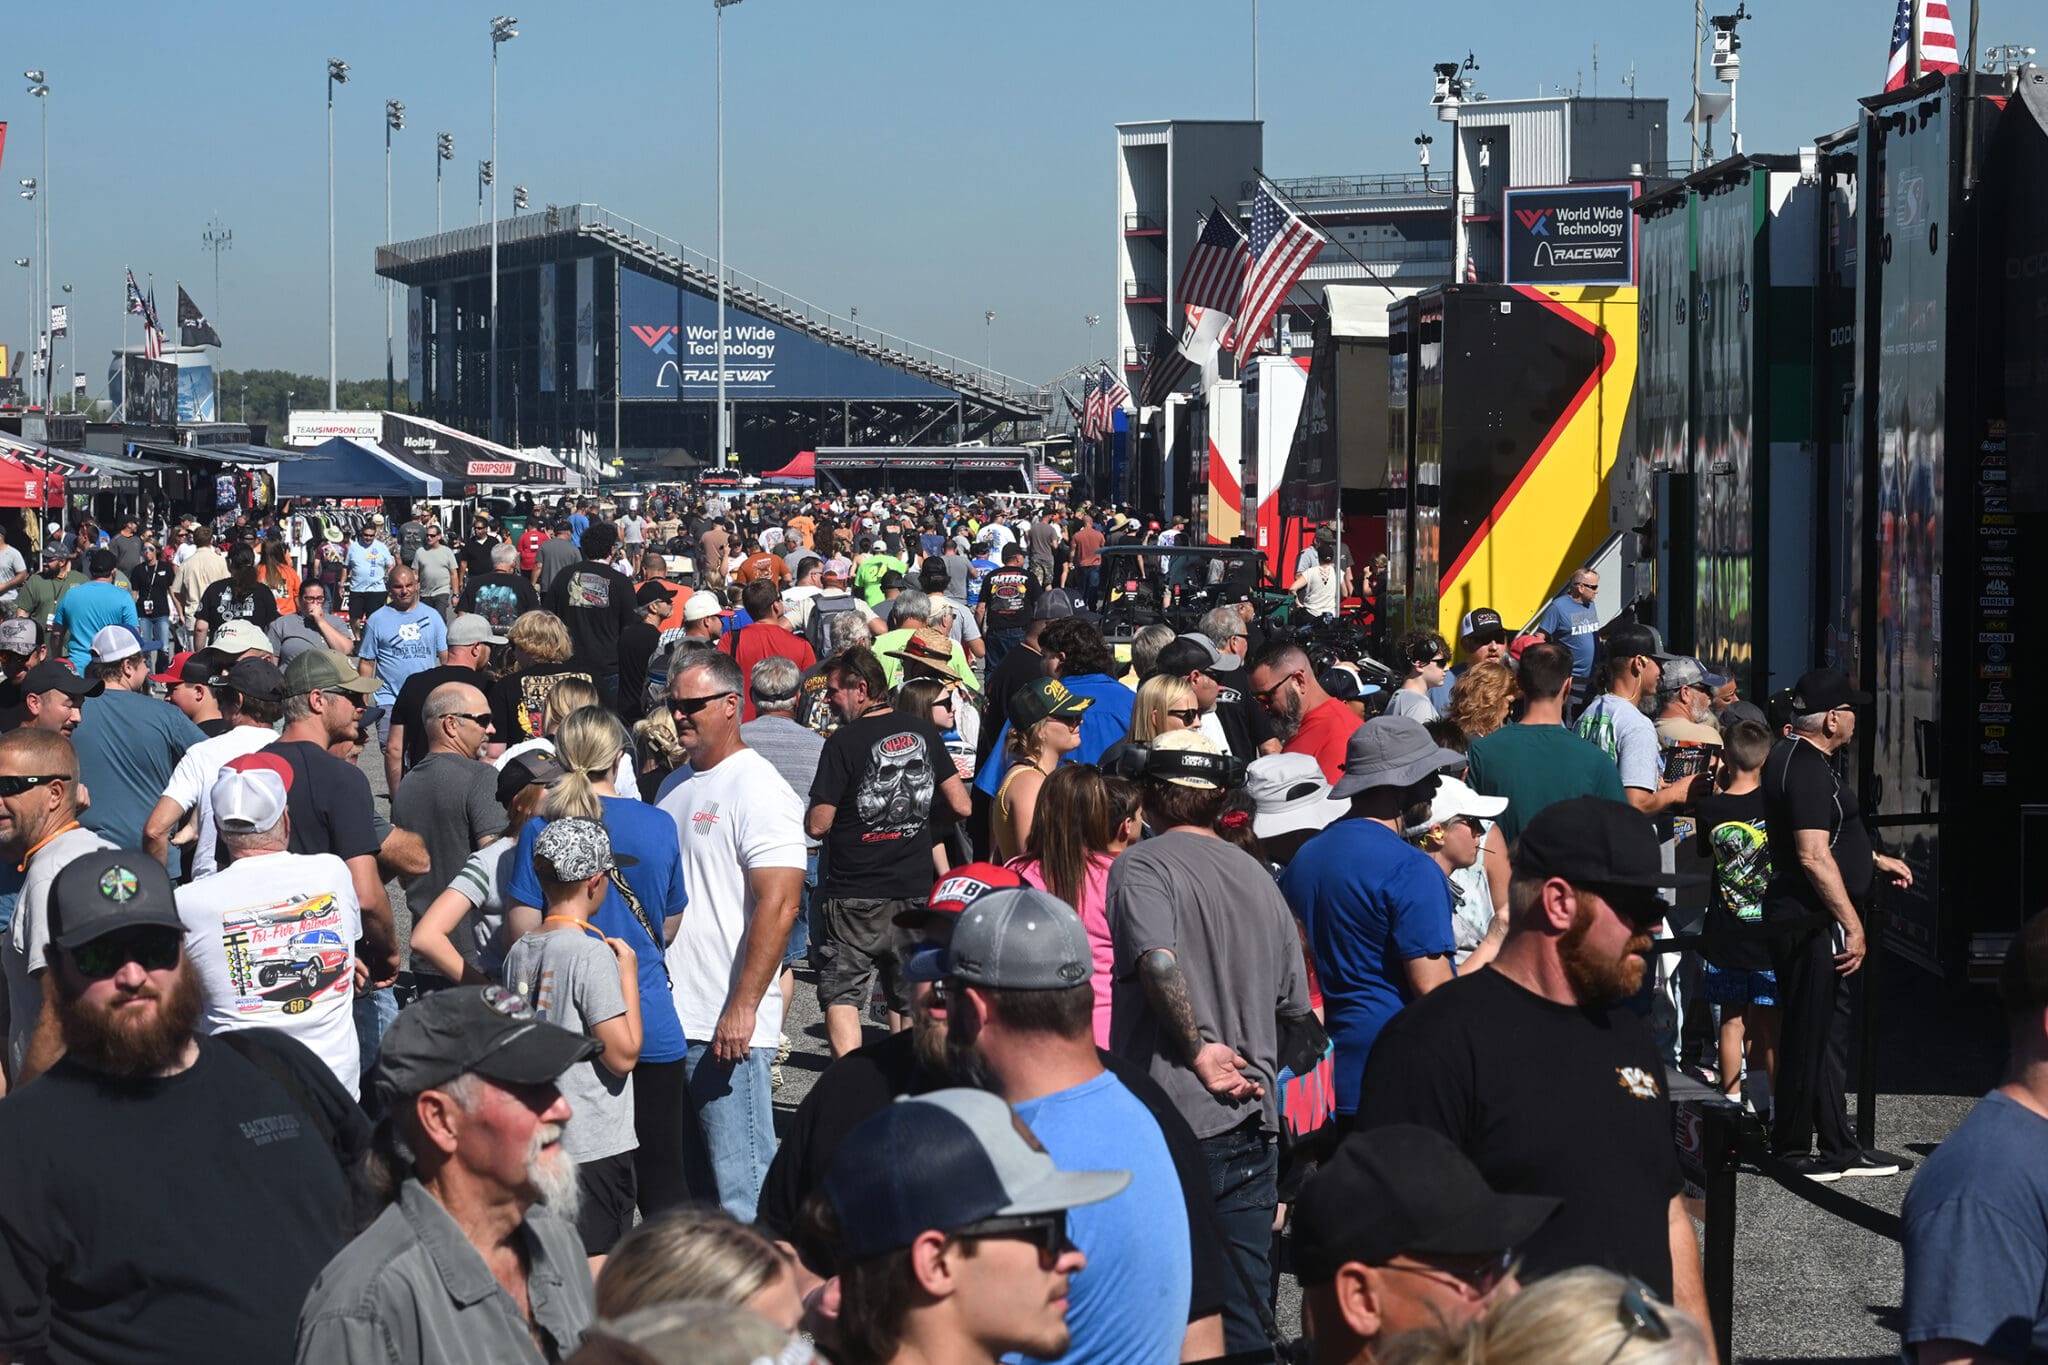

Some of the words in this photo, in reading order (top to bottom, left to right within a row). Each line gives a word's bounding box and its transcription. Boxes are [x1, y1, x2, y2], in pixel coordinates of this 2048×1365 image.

[1556, 206, 1590, 221] World
[1592, 206, 1624, 220] Wide
[1556, 221, 1623, 237] Technology
[1553, 247, 1622, 260] RACEWAY
[686, 325, 732, 341] Word
[735, 325, 776, 341] Wide
[1830, 325, 1857, 348] DOD
[296, 426, 375, 435] TEAMSIMPSON.COM
[403, 437, 437, 449] Holley
[470, 463, 512, 474] SIMPSON
[1571, 622, 1599, 636] LIONS
[886, 736, 913, 752] NHRA
[252, 924, 296, 944] Tri-Five
[298, 911, 340, 932] Nationals
[289, 999, 305, 1012] 60
